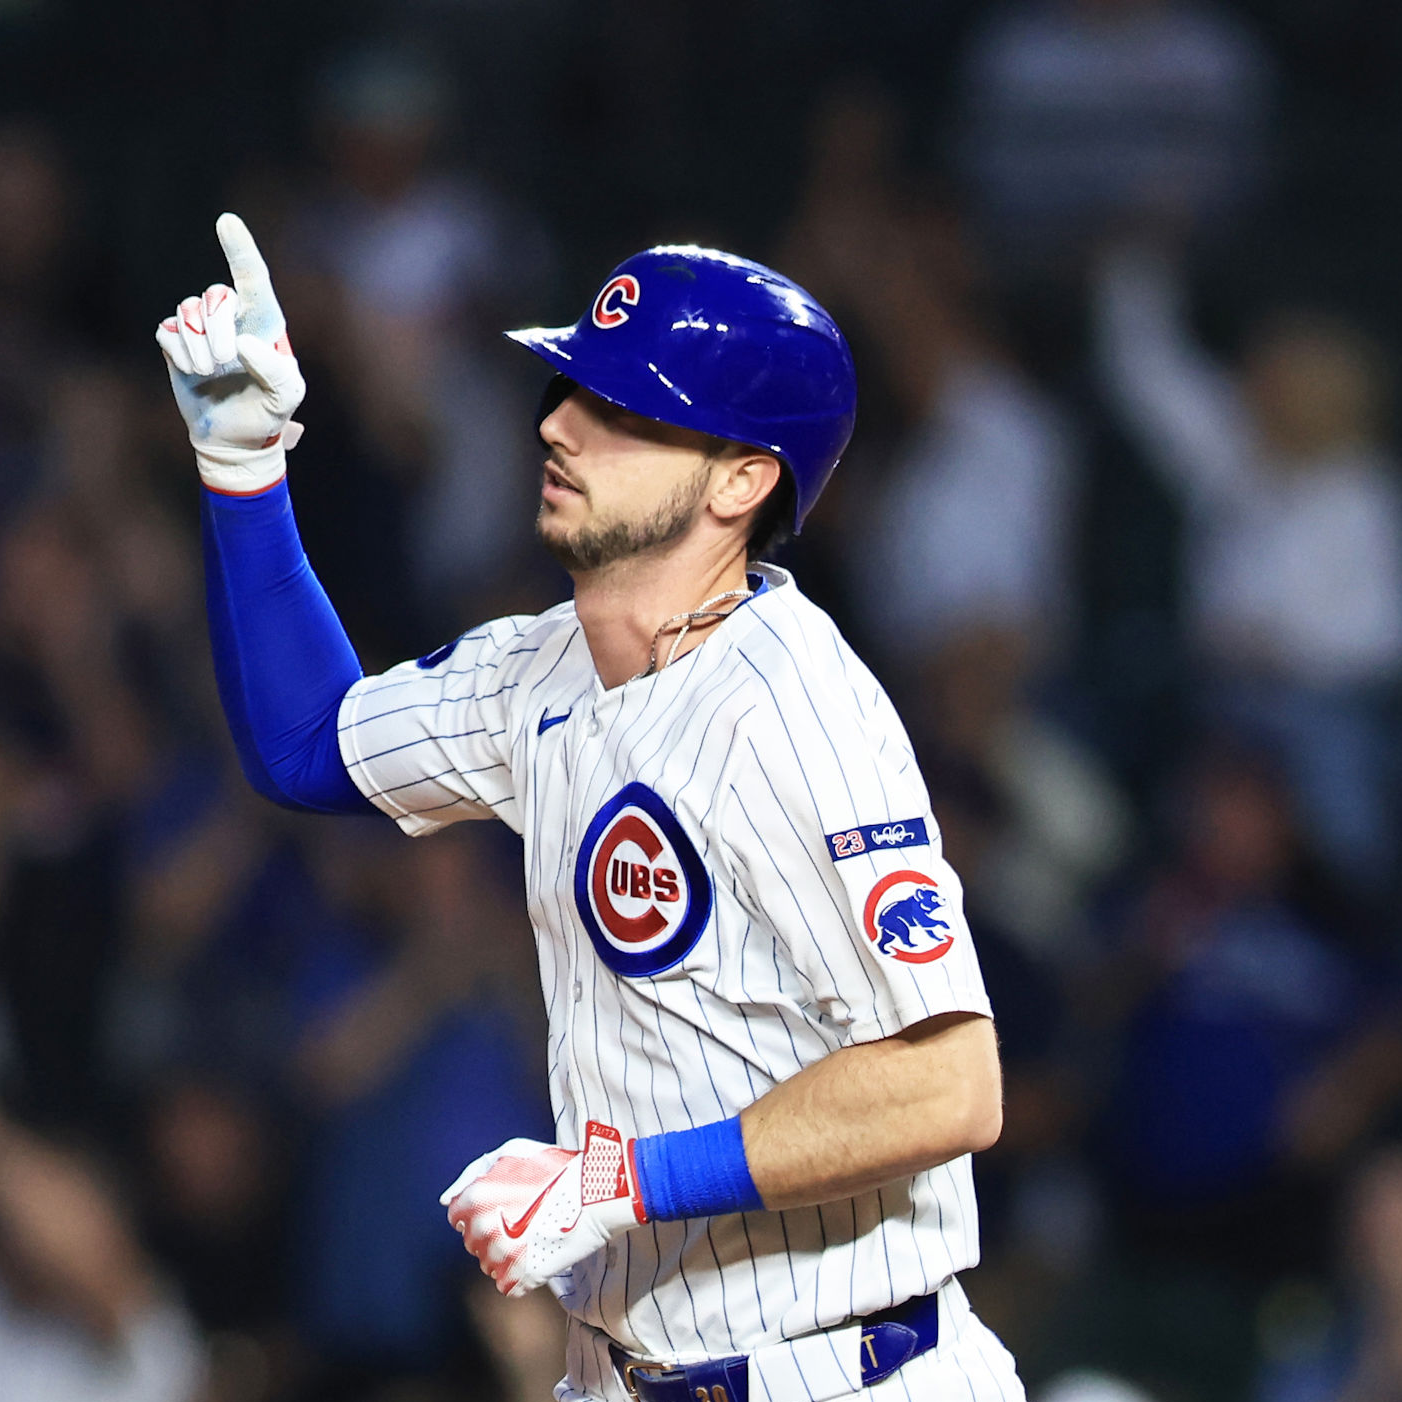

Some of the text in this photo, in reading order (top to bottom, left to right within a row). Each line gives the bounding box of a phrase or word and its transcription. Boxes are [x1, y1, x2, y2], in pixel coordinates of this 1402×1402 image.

[592, 274, 640, 329] C
[832, 830, 866, 857] 23
[592, 814, 680, 943] CUBS
